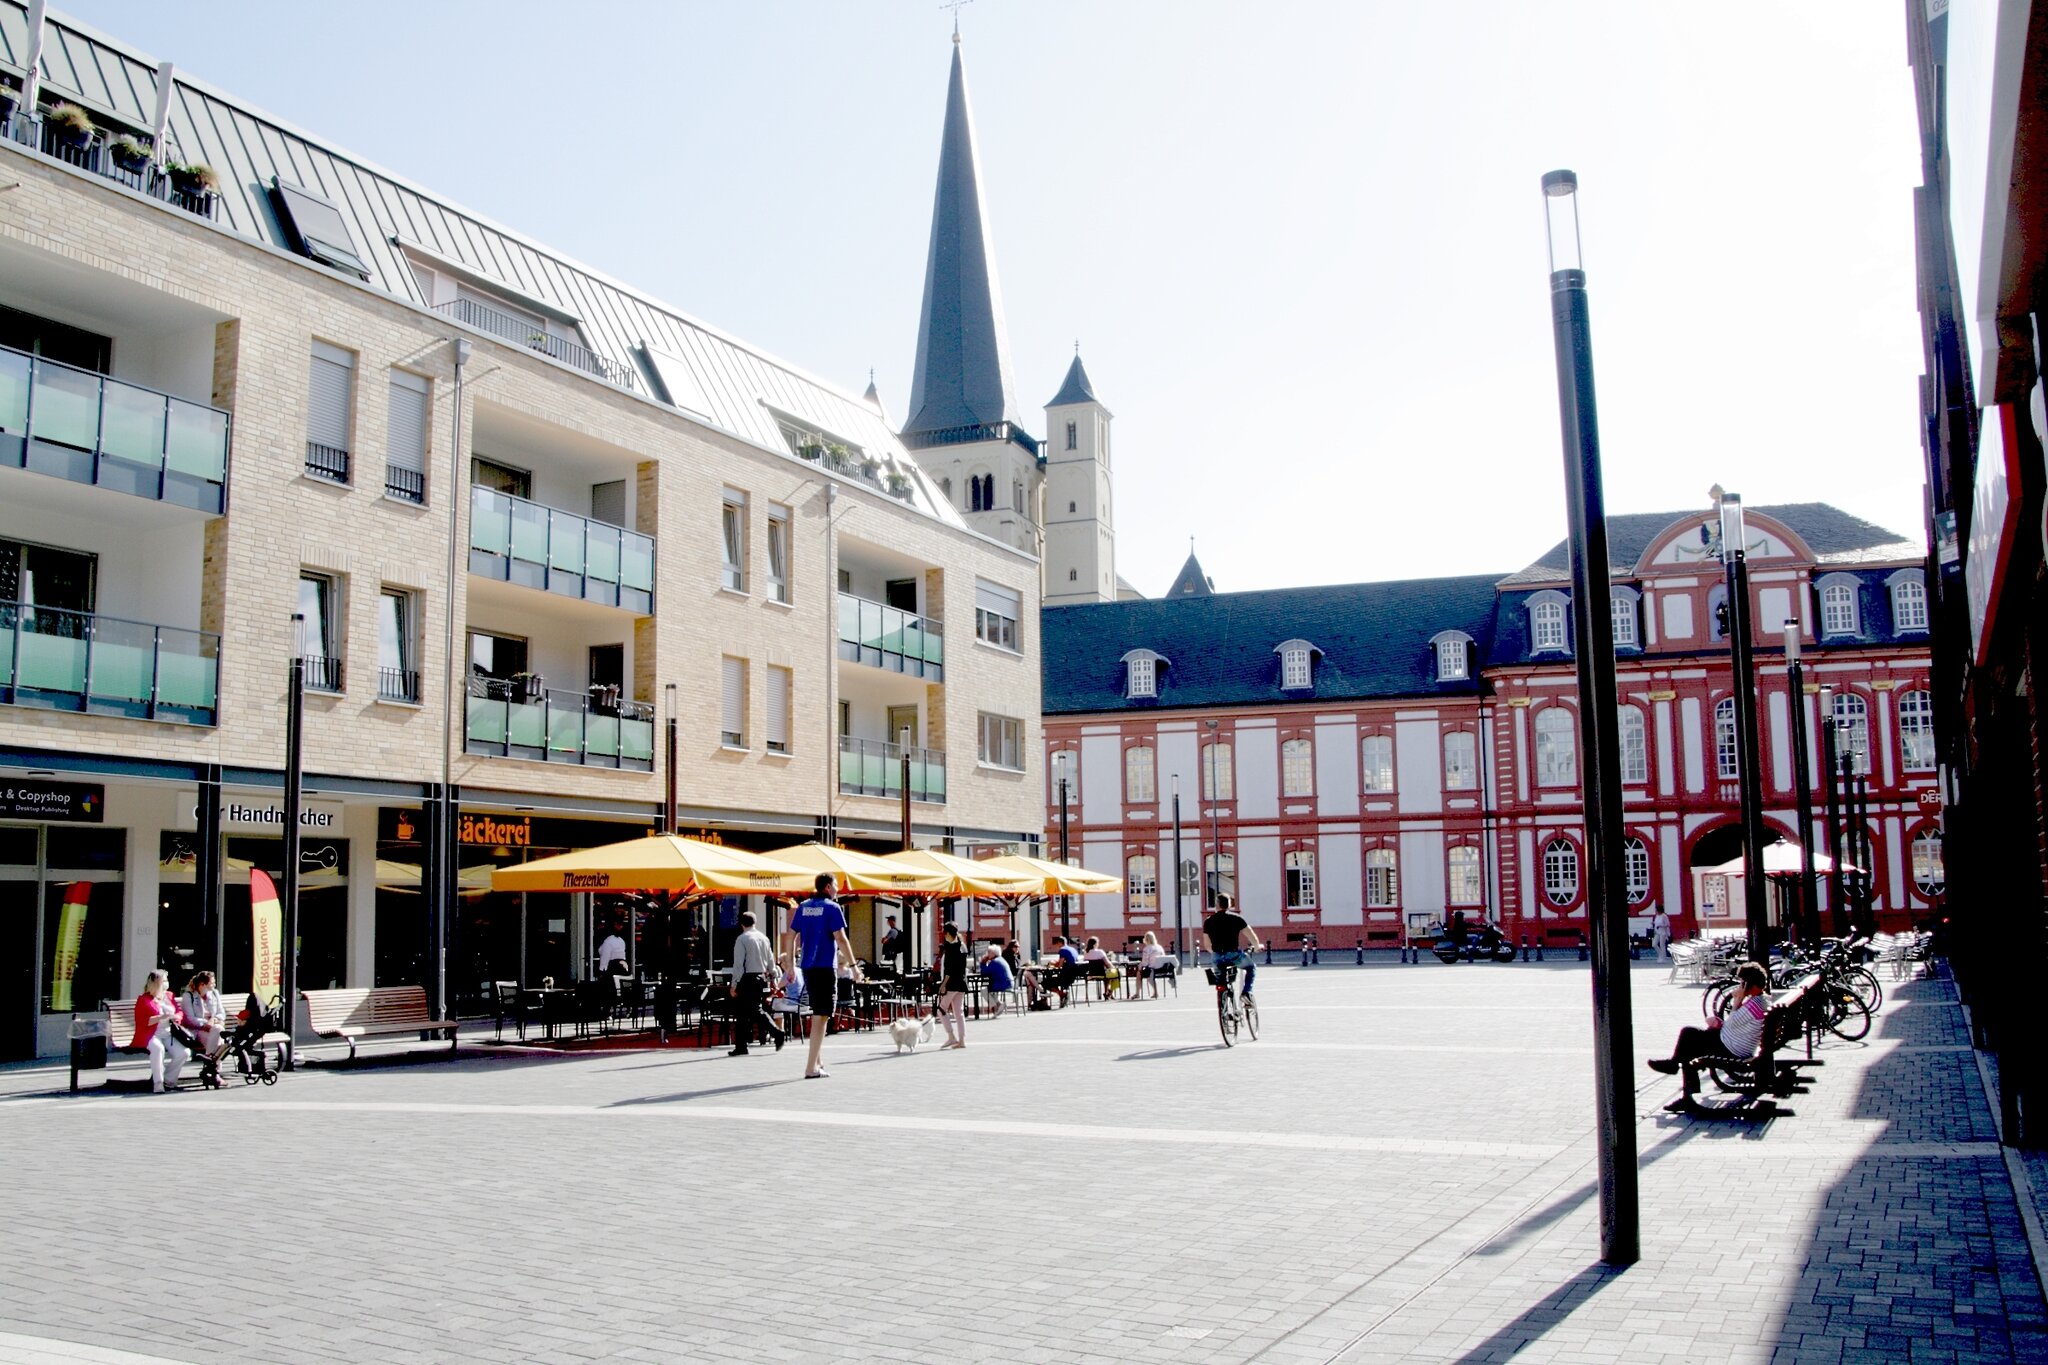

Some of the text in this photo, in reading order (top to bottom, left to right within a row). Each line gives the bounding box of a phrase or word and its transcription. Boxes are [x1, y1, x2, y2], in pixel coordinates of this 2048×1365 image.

[6, 788, 15, 799] &
[18, 789, 71, 805] Copyshop
[229, 804, 333, 826] Handmcher
[563, 872, 610, 888] Merzenich
